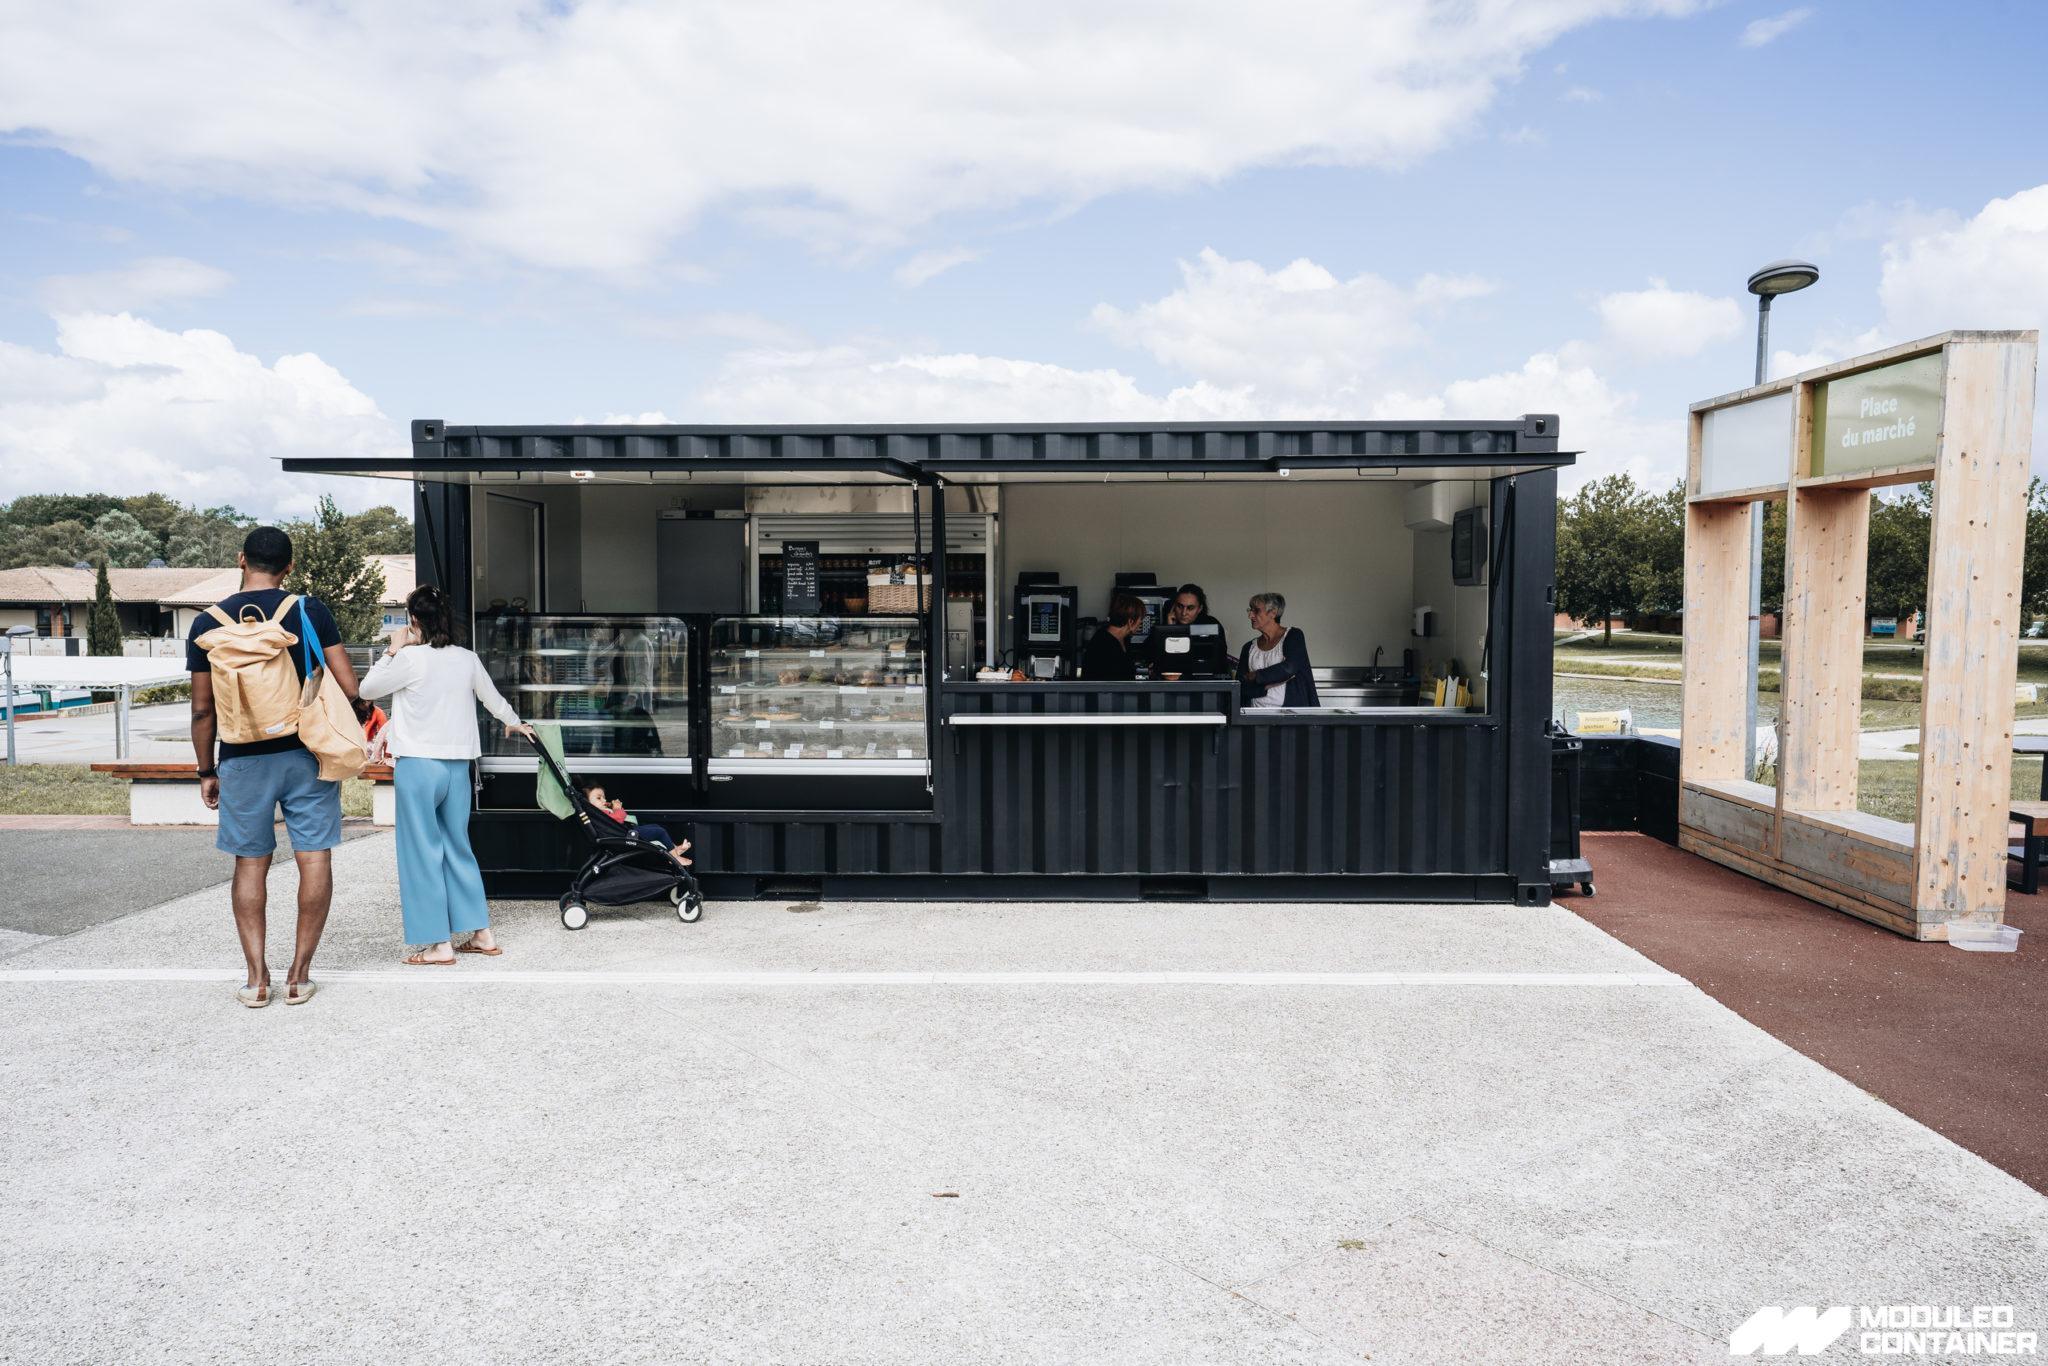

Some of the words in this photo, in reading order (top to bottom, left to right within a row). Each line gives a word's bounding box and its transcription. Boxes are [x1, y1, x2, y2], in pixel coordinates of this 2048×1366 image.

[1860, 397, 1898, 418] Place
[1841, 427, 1859, 448] du
[1862, 415, 1916, 444] marché
